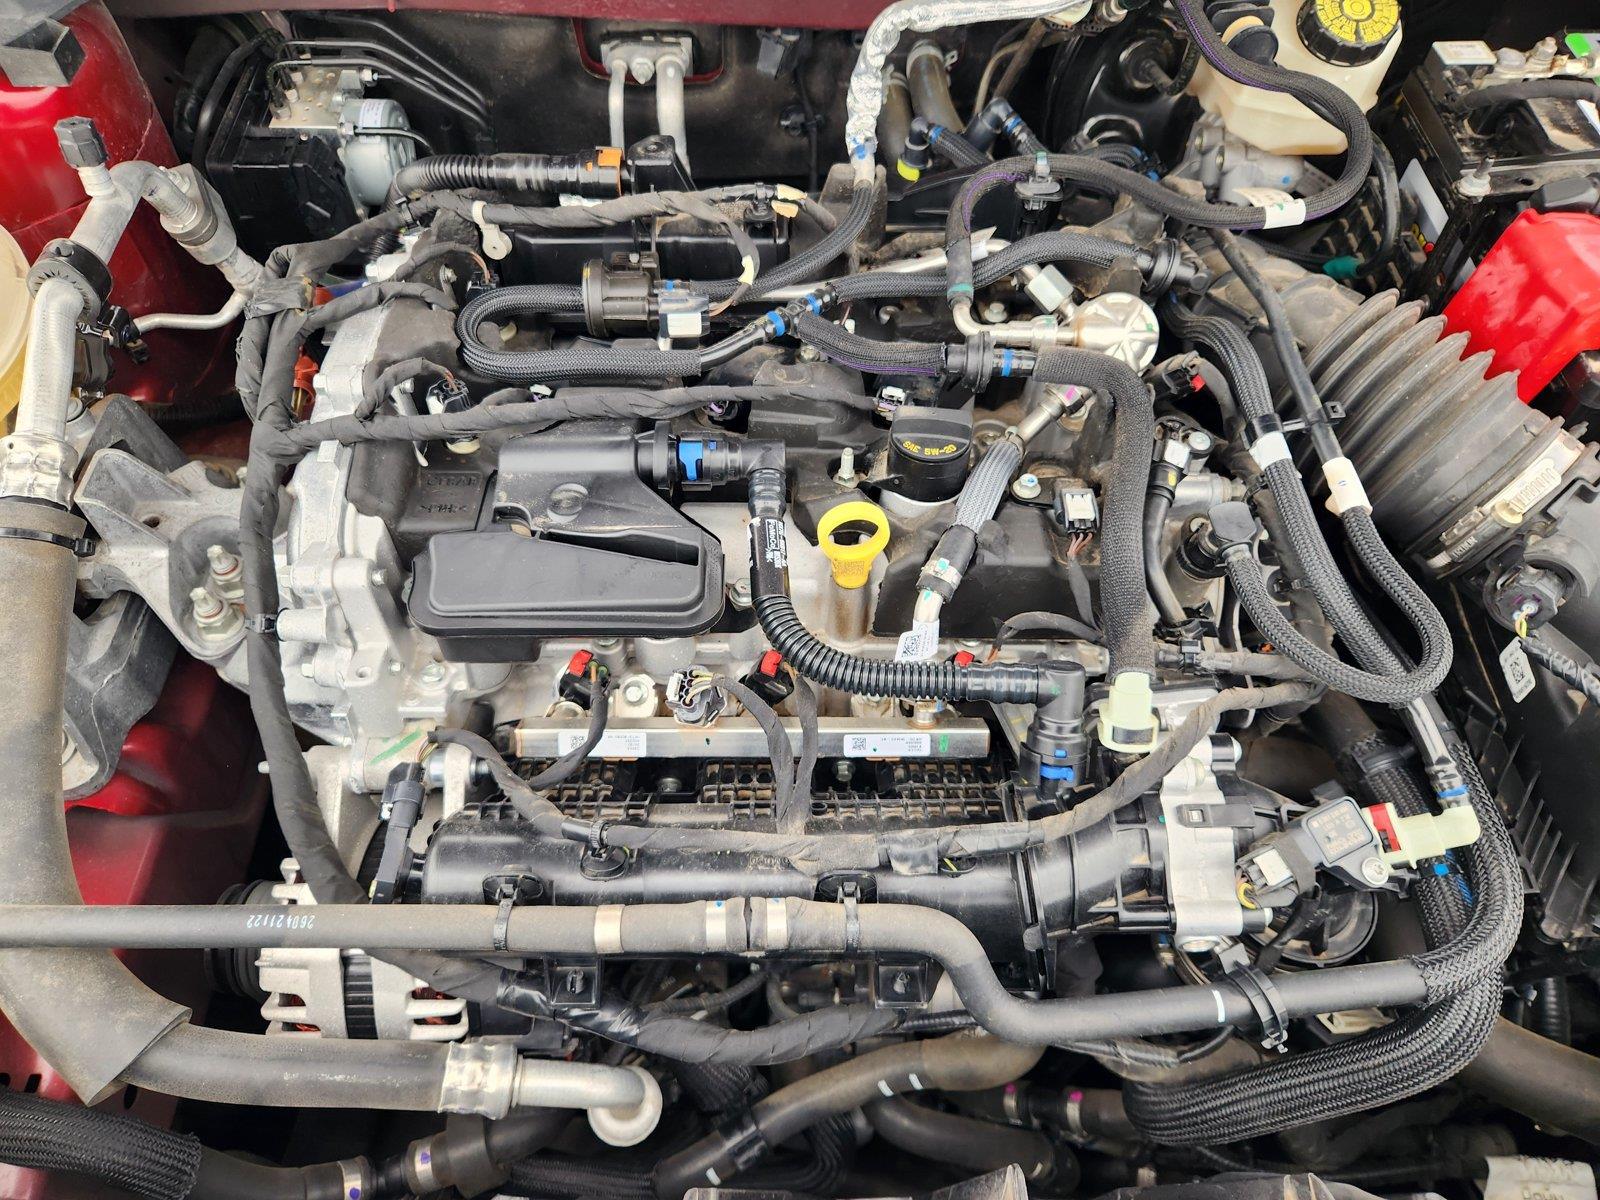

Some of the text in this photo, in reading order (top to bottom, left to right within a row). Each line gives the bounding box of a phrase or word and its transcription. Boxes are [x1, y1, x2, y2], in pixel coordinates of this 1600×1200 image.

[902, 440, 957, 456] SAE 5W-20
[768, 520, 777, 549] FoMoCo
